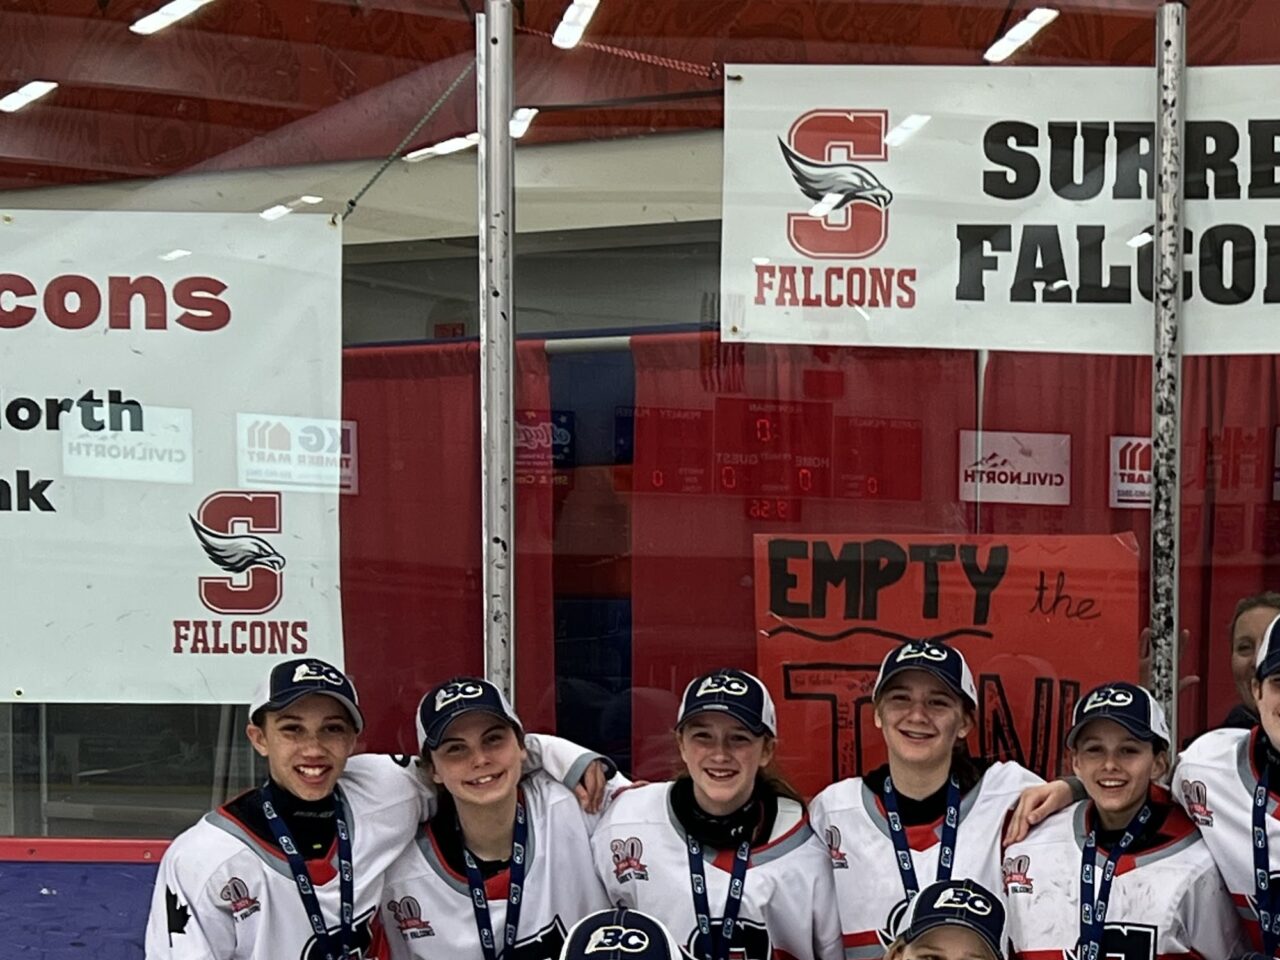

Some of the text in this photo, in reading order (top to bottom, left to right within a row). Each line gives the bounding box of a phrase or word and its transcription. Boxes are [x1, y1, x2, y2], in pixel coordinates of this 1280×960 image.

[754, 265, 917, 309] FALCONS
[0, 389, 144, 432] orth
[767, 539, 1102, 625] EMPTY the
[173, 620, 308, 654] FALCONS
[895, 642, 949, 663] BC
[291, 663, 344, 687] BC
[696, 674, 750, 697] BC
[434, 681, 484, 712] BC
[1083, 690, 1134, 714] BC
[933, 887, 994, 916] BC
[584, 925, 650, 954] BC
